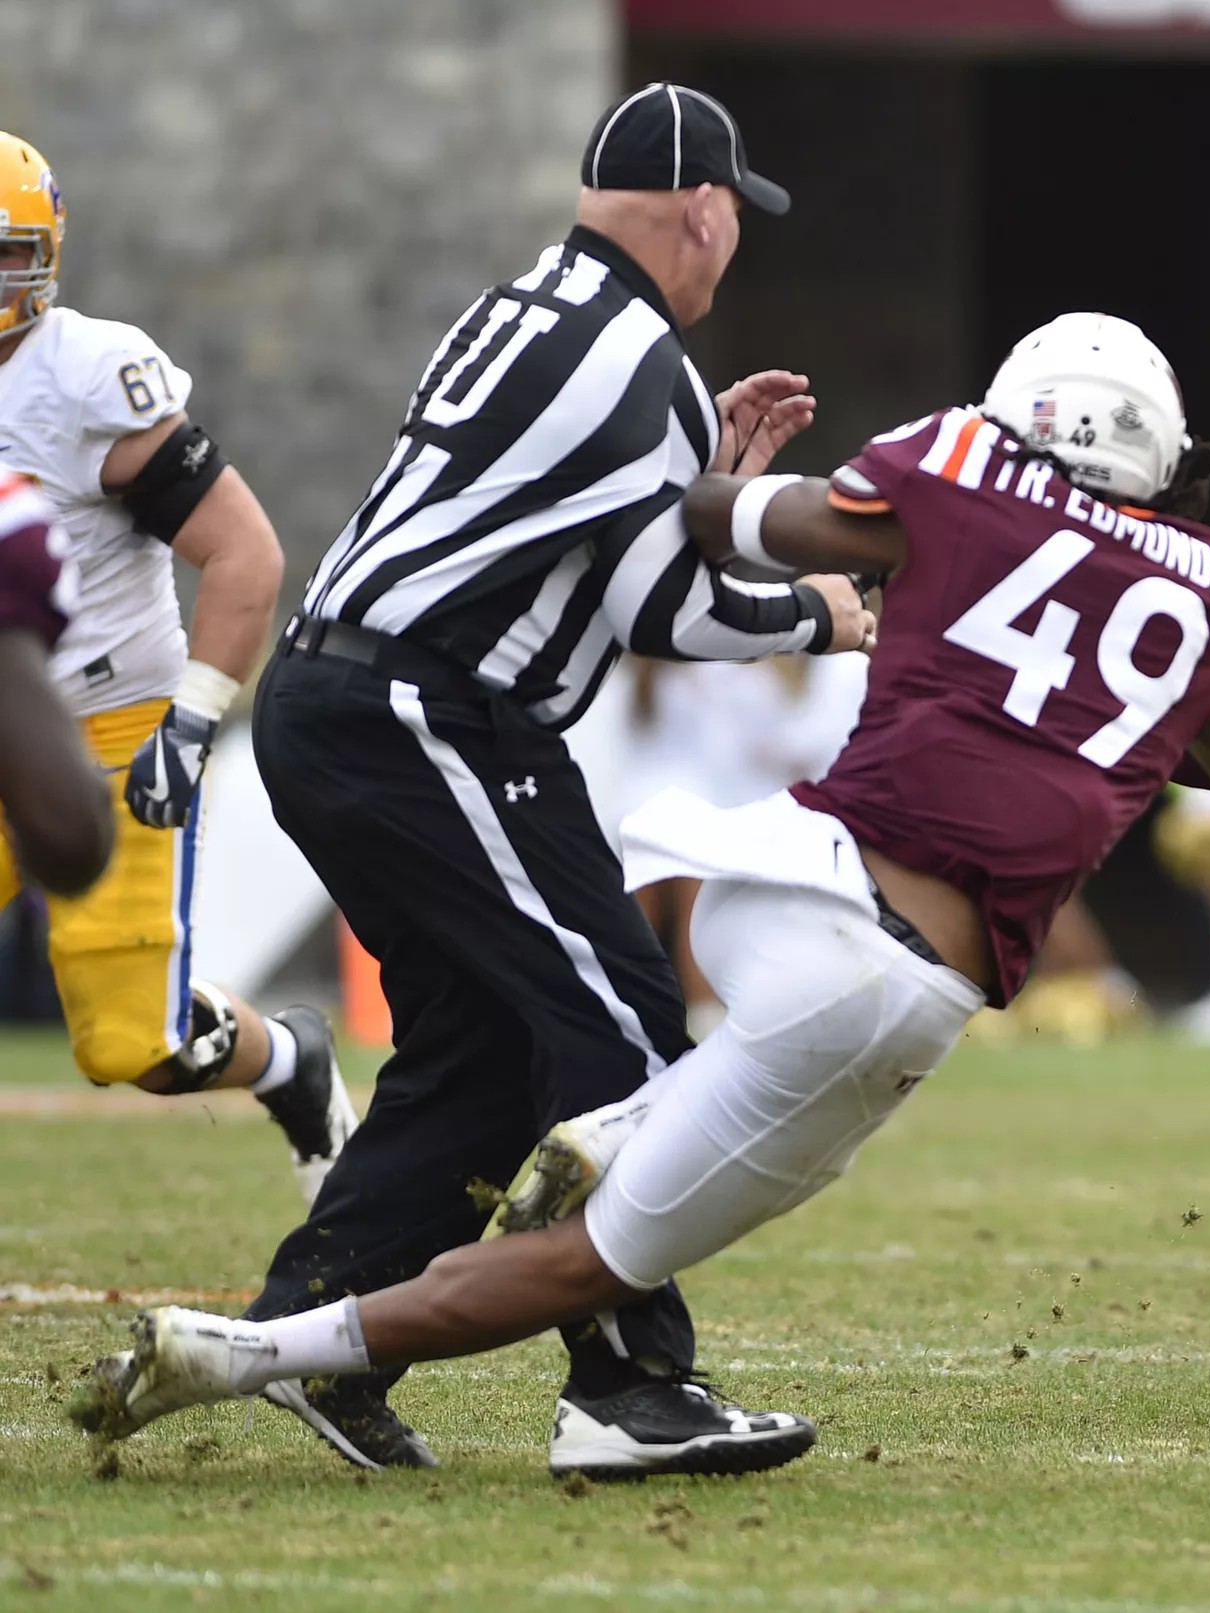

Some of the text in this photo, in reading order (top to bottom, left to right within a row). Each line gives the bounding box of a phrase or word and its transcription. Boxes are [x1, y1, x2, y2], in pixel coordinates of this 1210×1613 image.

[118, 356, 176, 414] 67
[1069, 428, 1096, 447] 49
[943, 529, 1210, 768] 49
